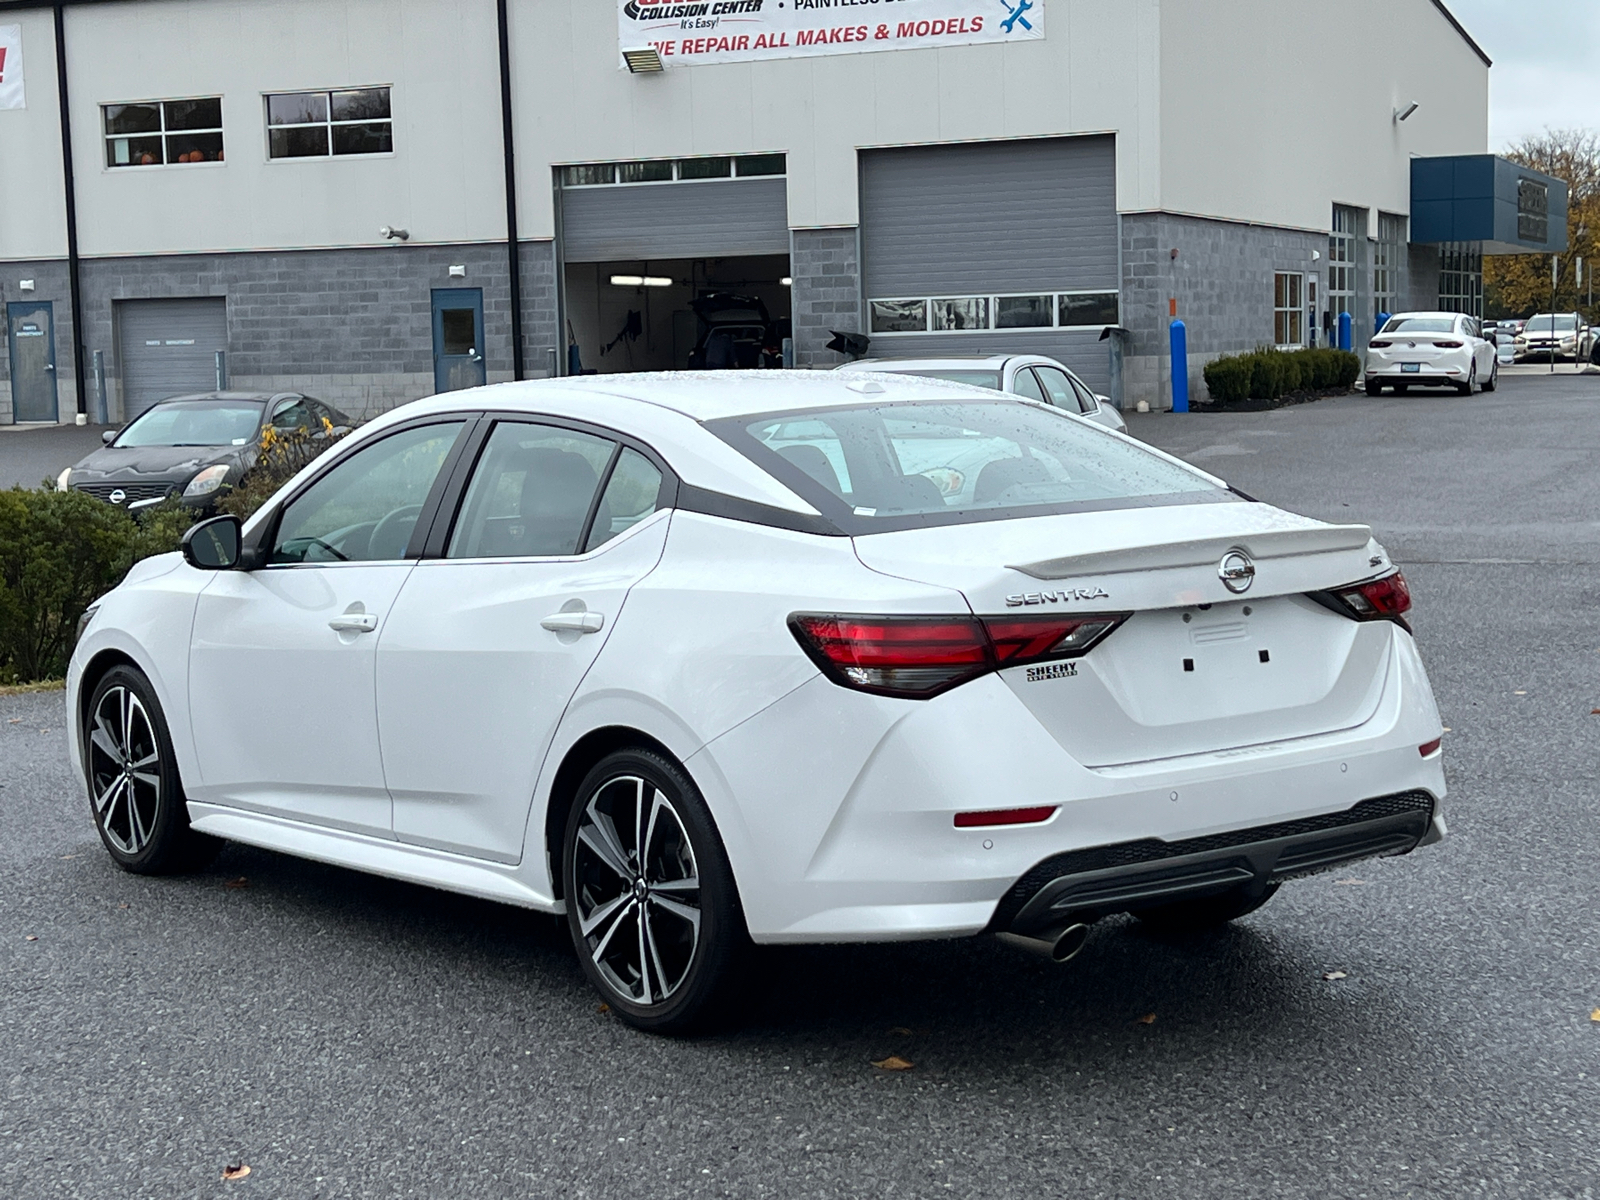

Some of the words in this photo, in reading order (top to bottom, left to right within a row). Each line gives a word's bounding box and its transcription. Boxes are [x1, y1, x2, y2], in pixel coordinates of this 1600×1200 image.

[639, 3, 709, 20] COLLISION
[711, 0, 762, 15] CENTER
[680, 19, 694, 29] It's
[695, 17, 720, 29] Easy!
[681, 35, 750, 55] REPAIR
[753, 31, 789, 49] ALL
[795, 25, 868, 46] MAKES
[874, 24, 890, 40] &
[896, 16, 984, 38] MODELS
[1005, 587, 1109, 607] SENTRA
[1026, 662, 1077, 676] SHEEHY
